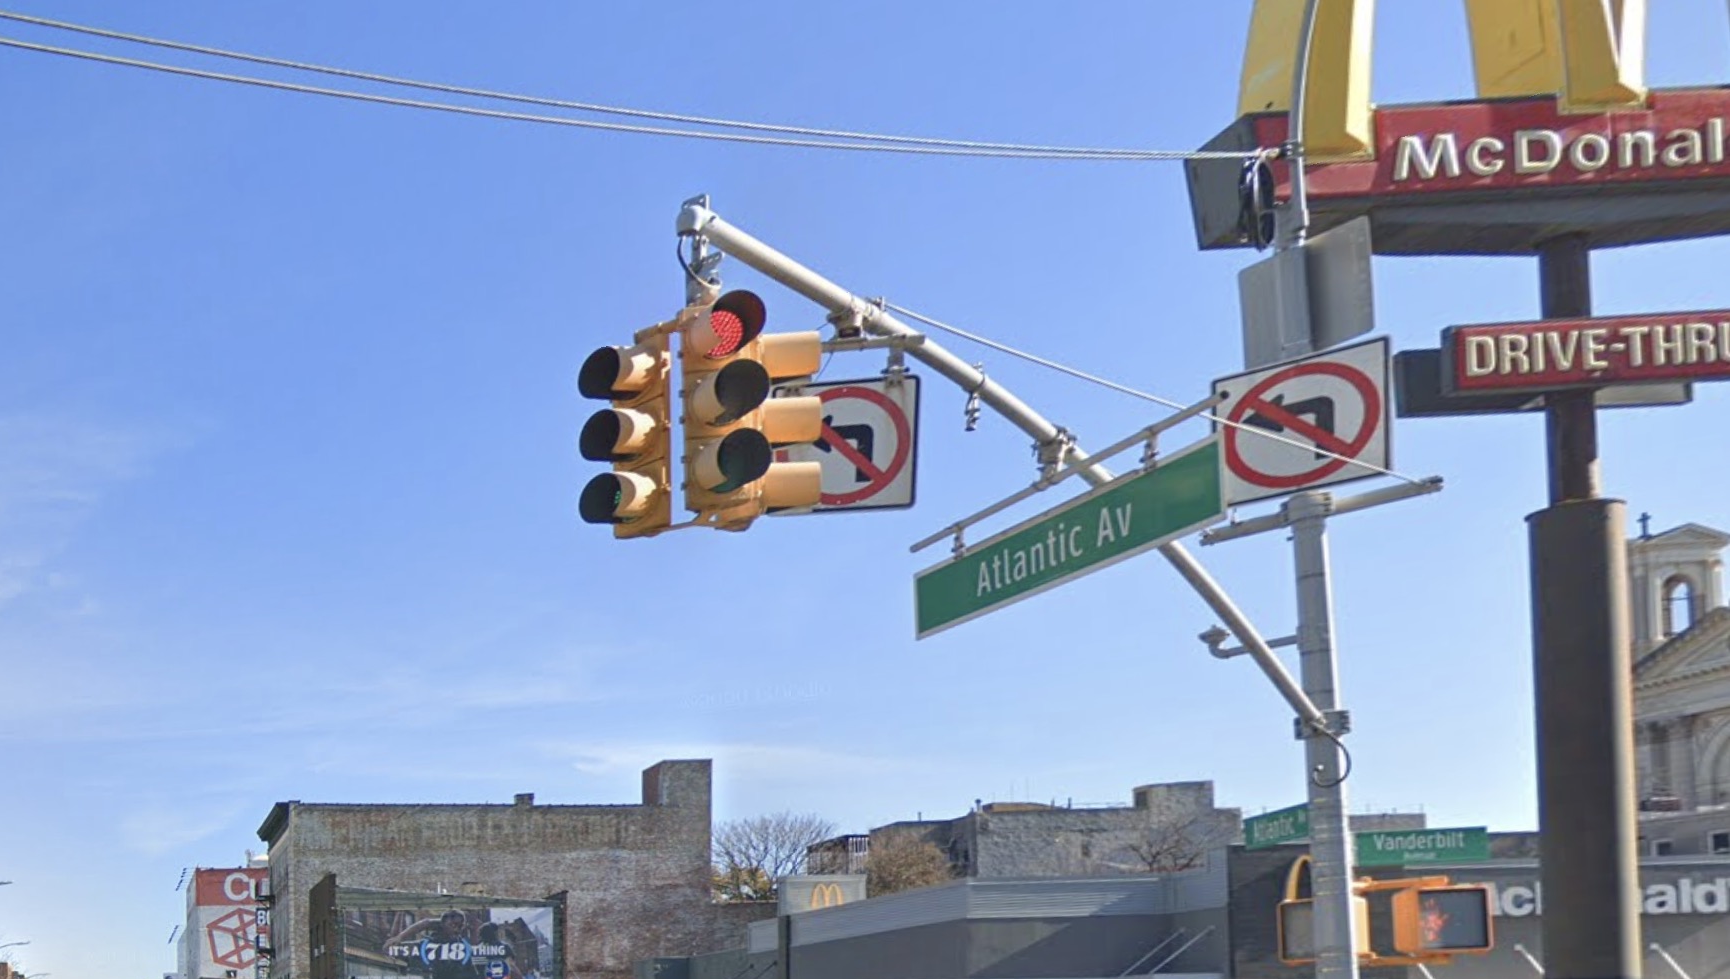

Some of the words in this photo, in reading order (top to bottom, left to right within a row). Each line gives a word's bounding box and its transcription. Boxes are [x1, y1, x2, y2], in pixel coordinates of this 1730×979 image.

[1393, 117, 1725, 181] McDonal
[976, 522, 1083, 597] Atlantic
[1096, 502, 1132, 547] Av
[1373, 831, 1465, 851] Vanderbilt
[388, 945, 410, 957] IT'S
[411, 945, 420, 957] A
[420, 937, 471, 966] (718)
[472, 944, 506, 957] THING
